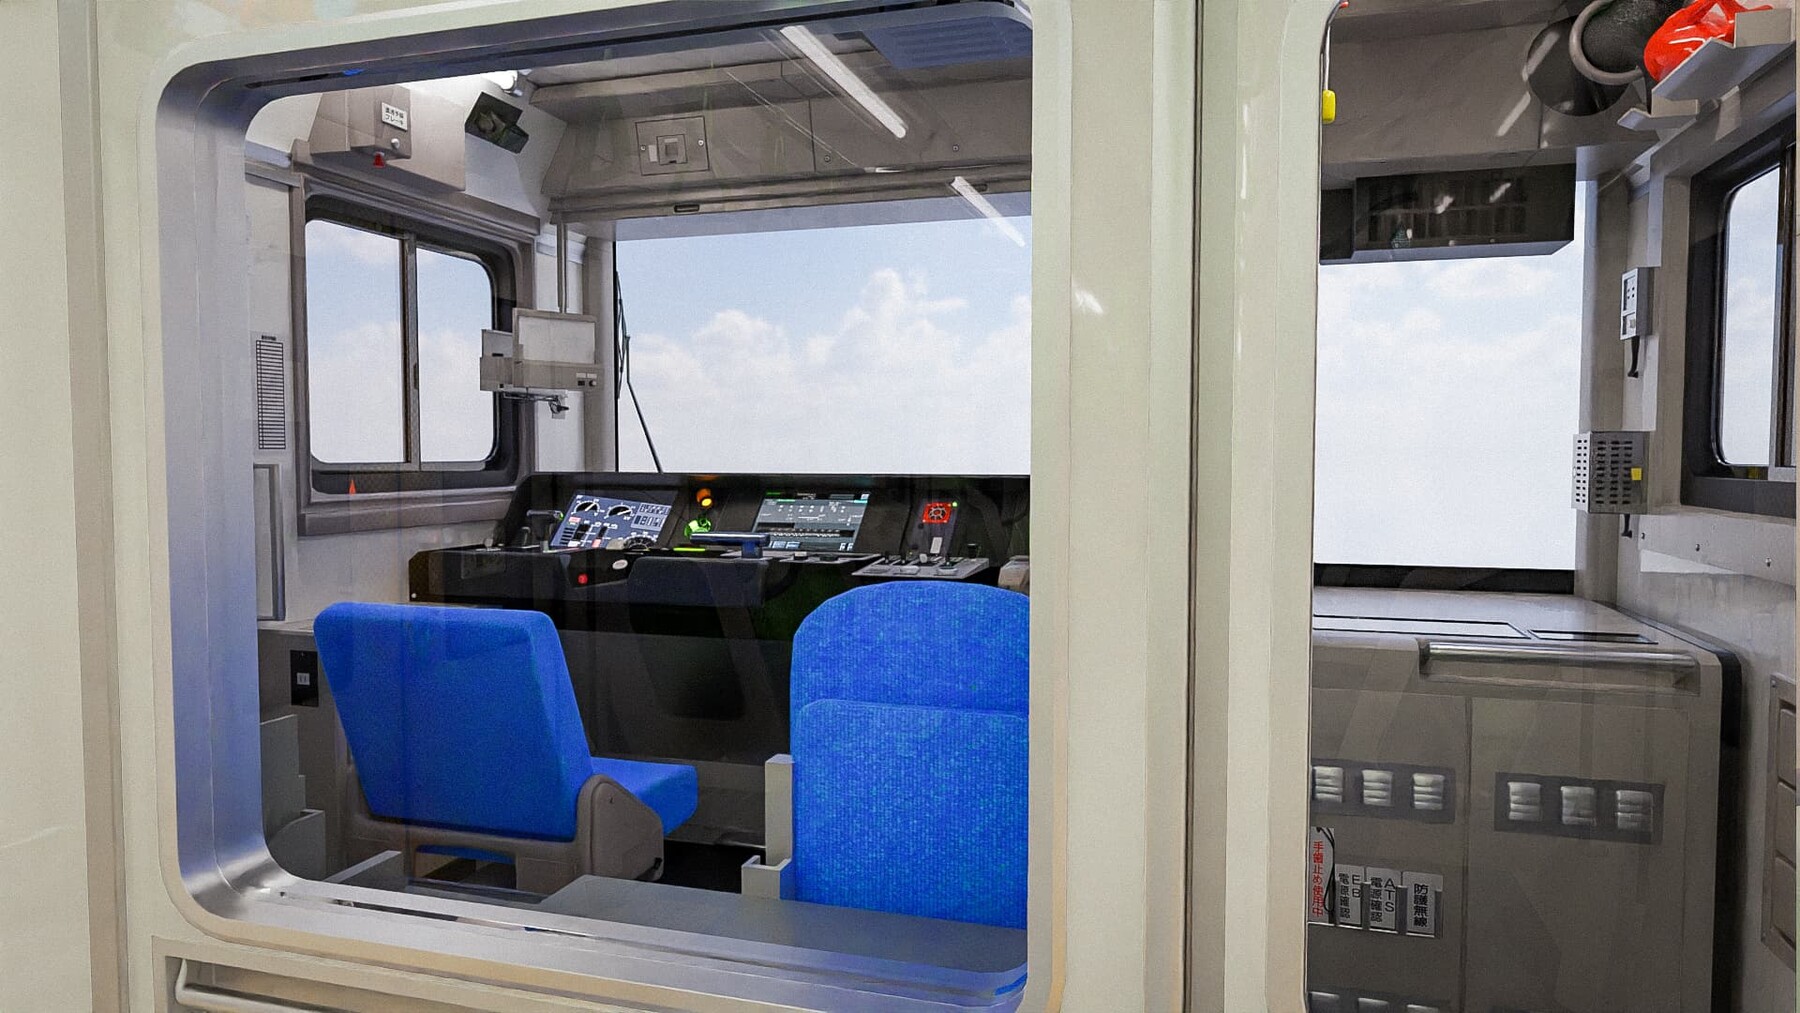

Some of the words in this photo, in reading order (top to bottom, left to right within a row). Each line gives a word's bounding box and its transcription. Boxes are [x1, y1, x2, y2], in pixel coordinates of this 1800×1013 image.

[1312, 841, 1325, 918] 手歯止め使用中
[1339, 872, 1351, 919] 電源確認
[1352, 874, 1361, 898] EB
[1370, 876, 1383, 923] 電源確認
[1384, 877, 1396, 913] ATS
[1413, 883, 1429, 928] 防護無線
